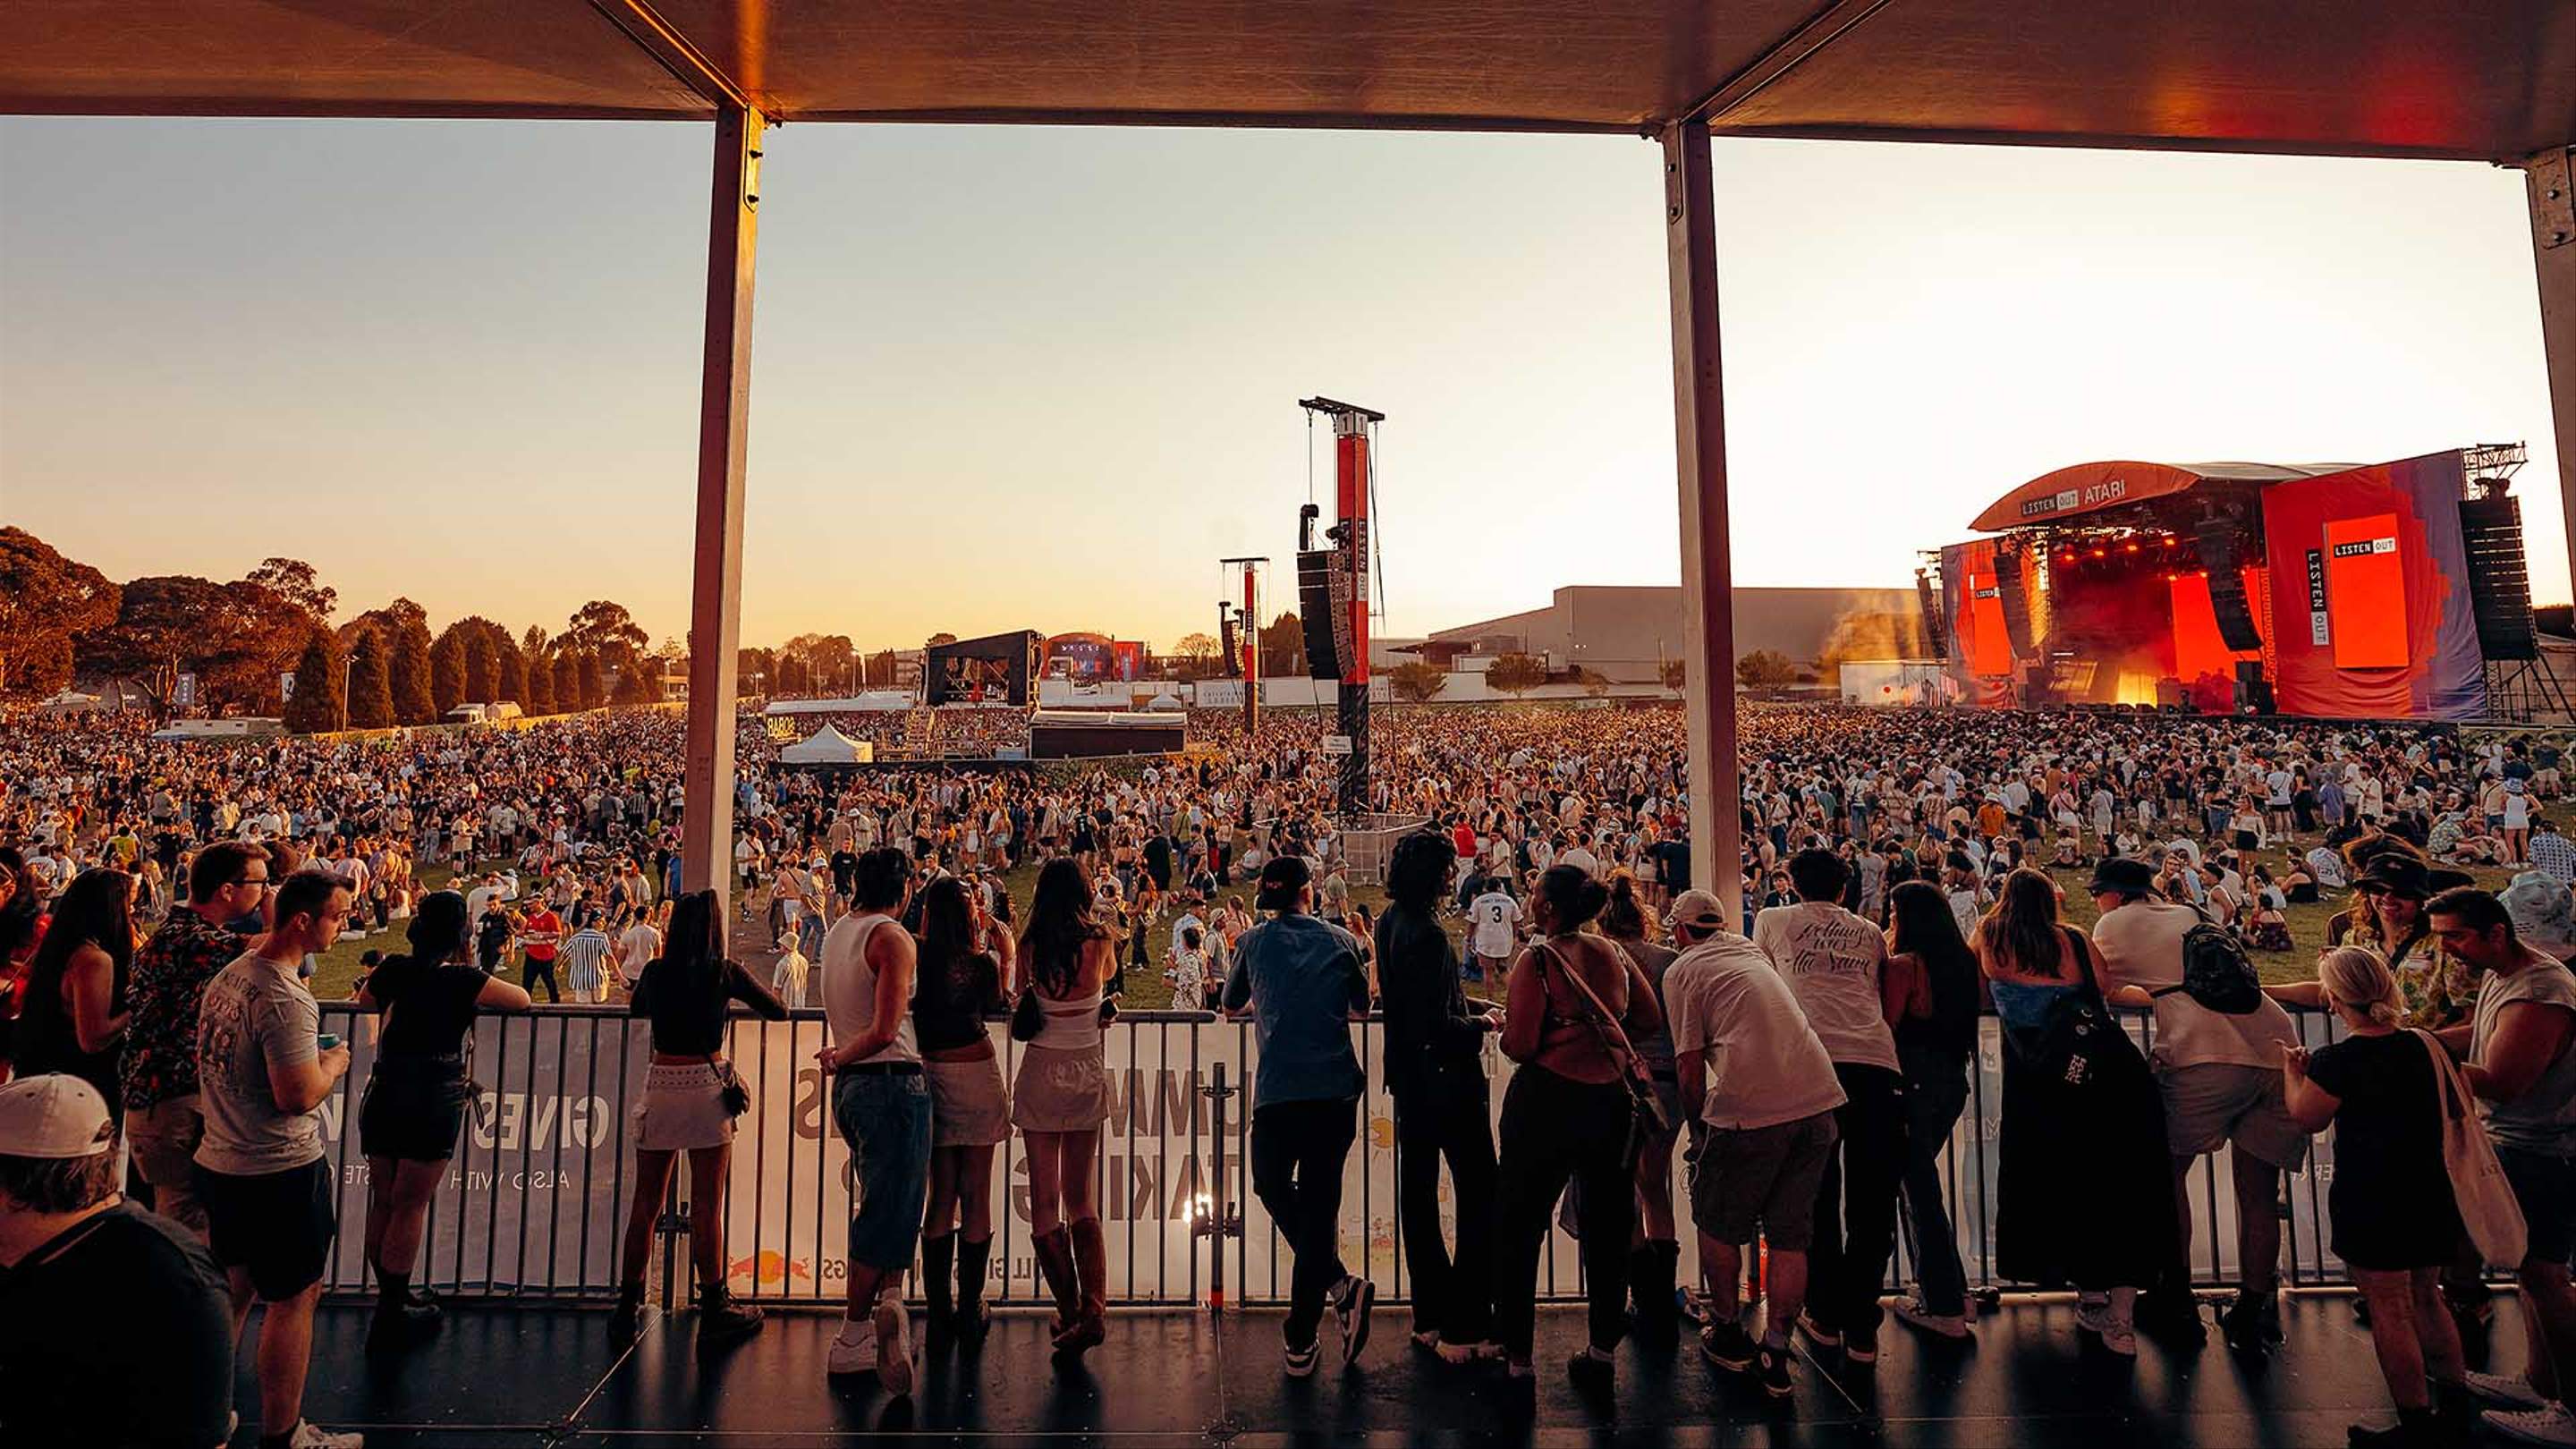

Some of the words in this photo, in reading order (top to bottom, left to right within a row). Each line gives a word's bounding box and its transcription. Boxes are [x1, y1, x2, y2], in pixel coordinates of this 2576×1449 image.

[2022, 498, 2056, 515] LISTEN
[2058, 492, 2078, 507] OUT
[2084, 479, 2126, 504] ATARI
[2334, 542, 2371, 555] LISTEN
[2375, 539, 2394, 550] OUT
[2308, 553, 2324, 608] LISTEN
[2315, 615, 2326, 641] OUT
[1491, 906, 1502, 923] 3
